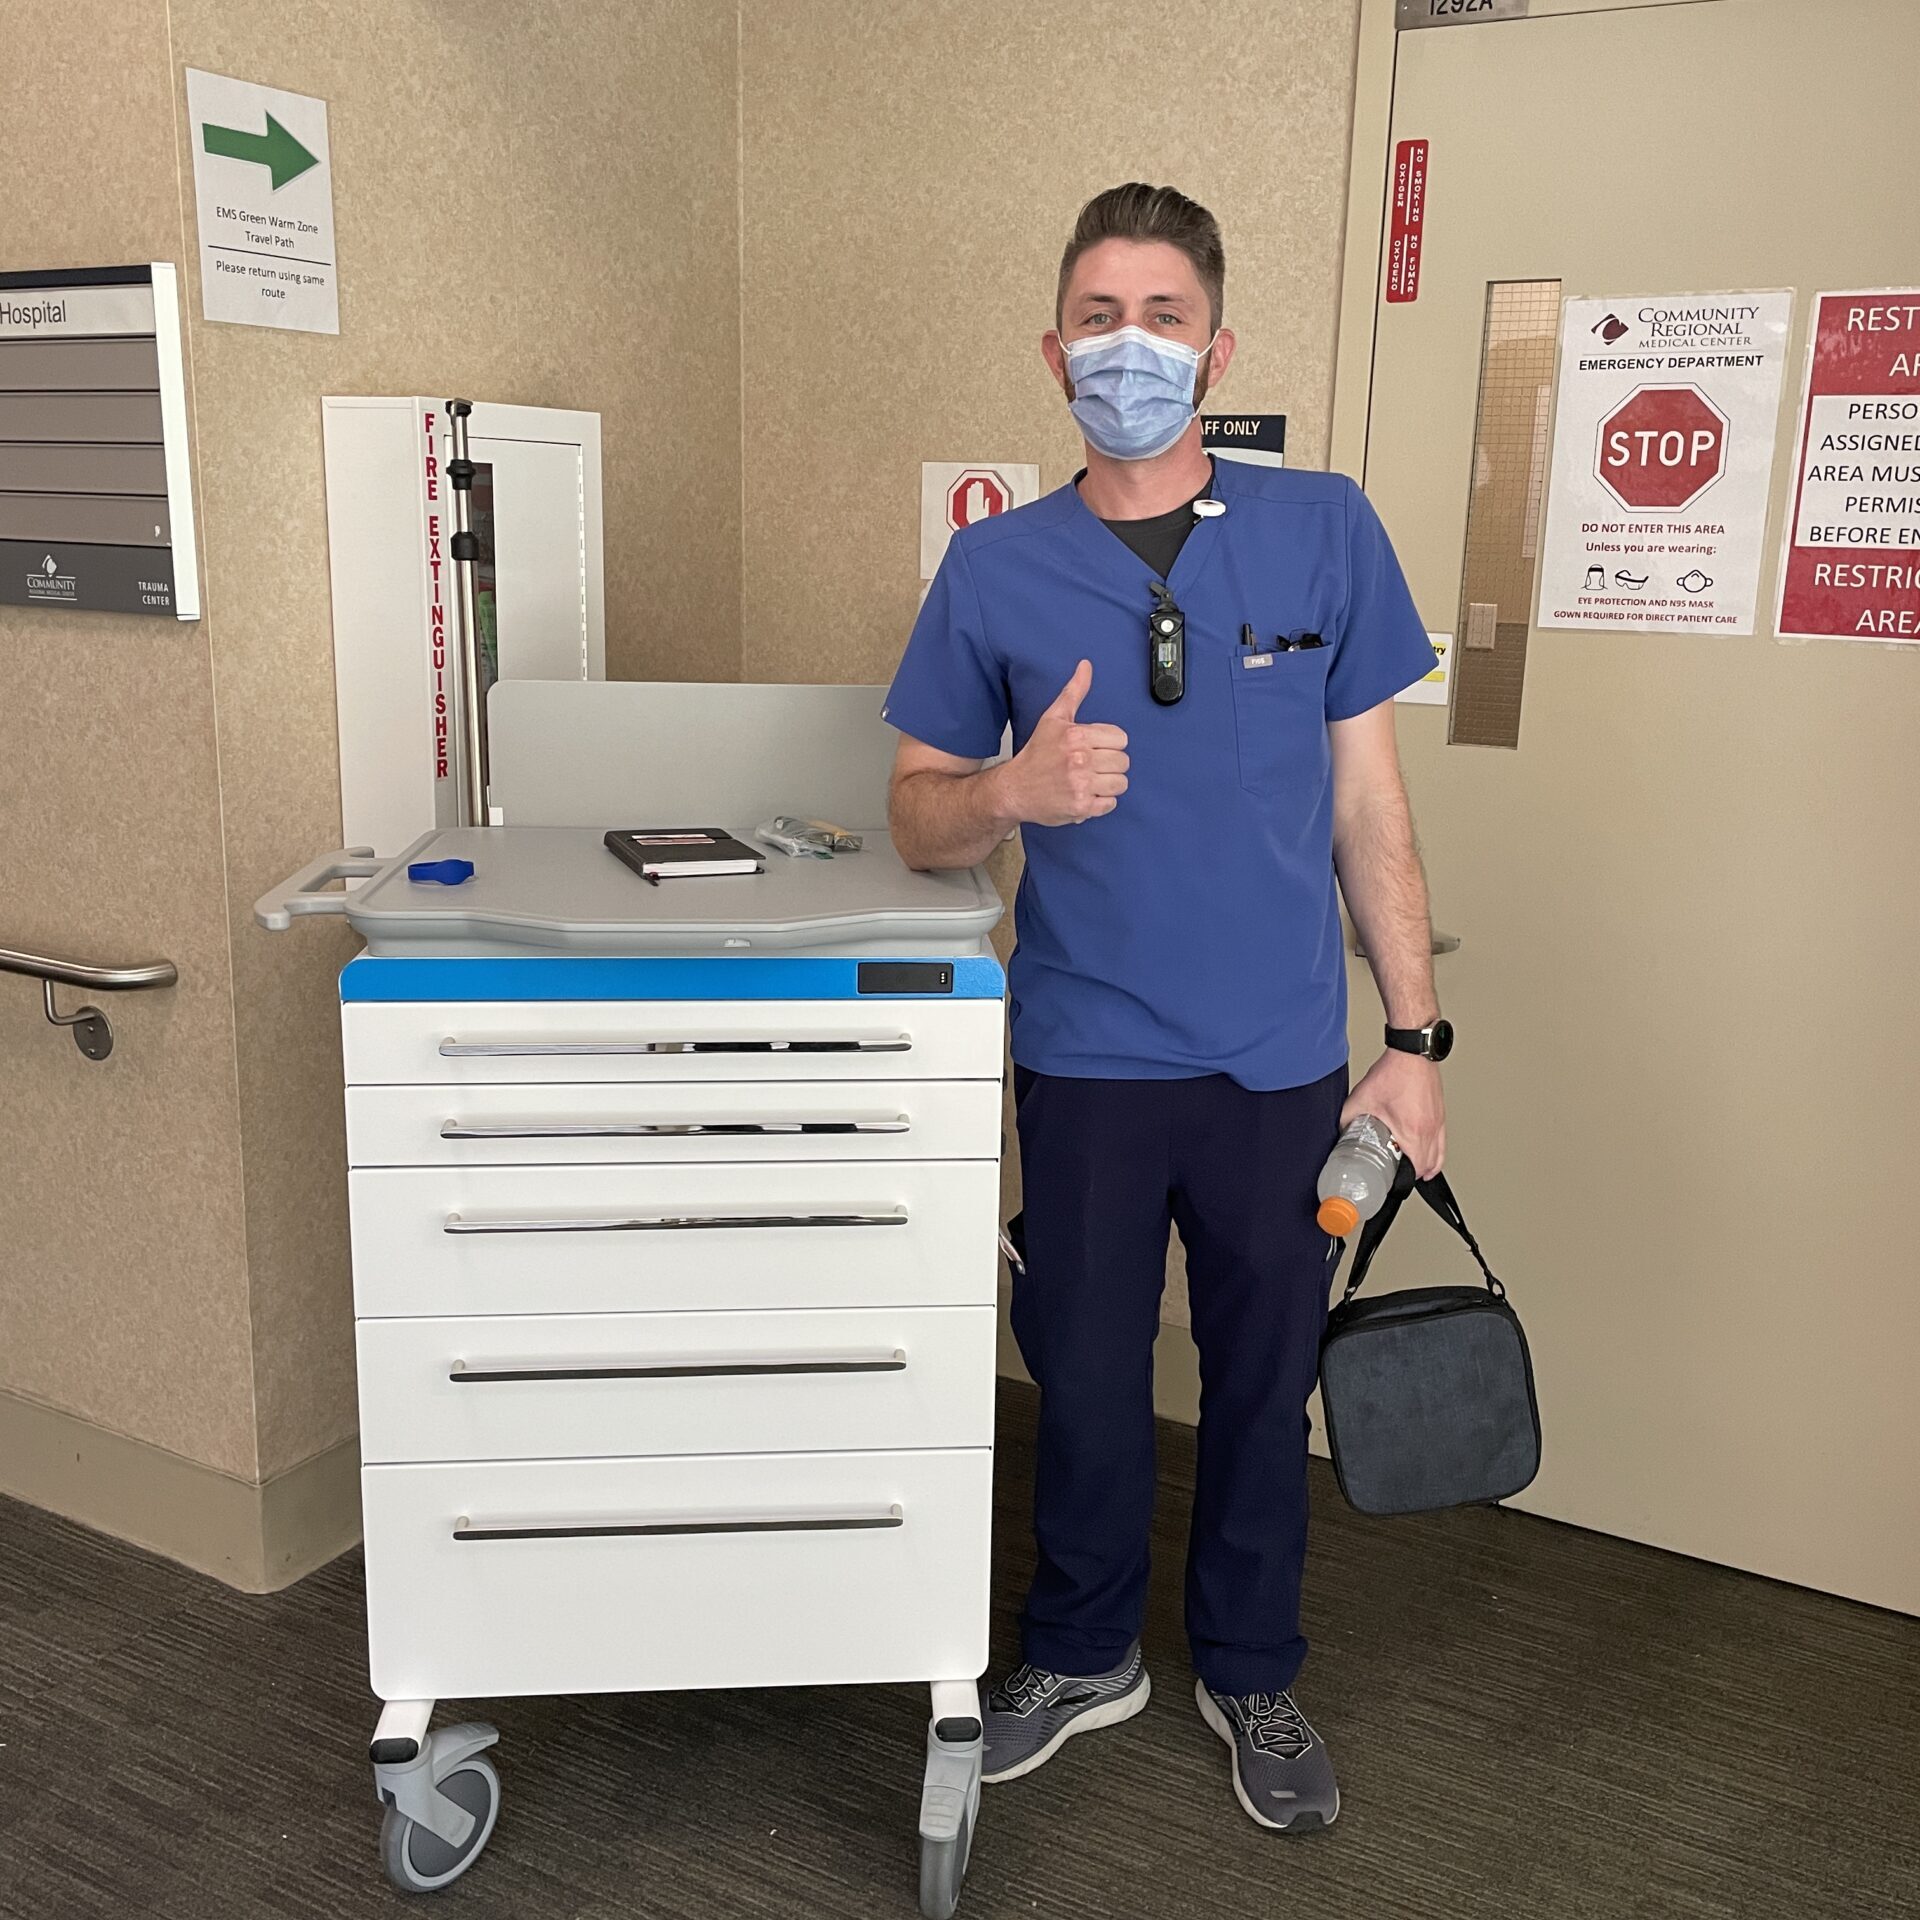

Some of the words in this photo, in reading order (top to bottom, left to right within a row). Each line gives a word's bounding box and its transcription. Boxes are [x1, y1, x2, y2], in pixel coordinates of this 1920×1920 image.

[1416, 148, 1424, 163] NO
[1397, 163, 1406, 207] OXYGEN
[1412, 170, 1422, 222] SMOKING
[216, 206, 236, 220] EMS
[239, 210, 266, 226] Green
[268, 215, 295, 230] Warm
[297, 220, 318, 234] Zone
[245, 230, 272, 245] Travel
[275, 235, 295, 248] Path
[1410, 235, 1417, 249] NO
[216, 260, 246, 275] Please
[248, 266, 276, 279] return
[278, 270, 301, 285] using
[302, 275, 325, 286] same
[1391, 240, 1401, 291] OXYGENO
[1407, 256, 1416, 293] FUMAR
[261, 287, 286, 299] route
[0, 300, 66, 329] Hospital
[1638, 306, 1760, 323] COMMUNITY
[1847, 306, 1920, 332] REST
[1650, 322, 1743, 338] REGIONAL
[1638, 337, 1696, 349] MEDICAL
[1700, 336, 1752, 347] CENTER
[1579, 357, 1665, 371] EMERGENCY
[1667, 355, 1765, 369] DEPARTMENT
[1849, 403, 1918, 420] PERSO
[1223, 421, 1260, 436] ONLY
[425, 413, 438, 501] FIRE
[1607, 430, 1715, 467] STOP
[1807, 465, 1864, 482] AREA
[1871, 466, 1920, 483] MUS
[1581, 523, 1598, 533] DO
[1601, 523, 1626, 533] NOT
[1628, 524, 1663, 534] ENTER
[1666, 524, 1692, 534] THIS
[1694, 524, 1725, 535] AREA
[1809, 526, 1891, 544] BEFORE
[1586, 542, 1621, 552] Unless
[1624, 544, 1646, 555] you
[1647, 544, 1665, 553] are
[1668, 543, 1717, 556] wearing:
[27, 576, 76, 591] COMMUNITY
[138, 581, 169, 593] TRAUMA
[142, 594, 170, 606] CENTER
[1578, 597, 1592, 605] EYE
[1594, 597, 1647, 607] PROTECTION
[1648, 598, 1668, 607] AND
[1669, 599, 1687, 608] N95
[1688, 600, 1714, 609] MASK
[1553, 610, 1581, 619] GOWN
[1583, 611, 1624, 622] REQUIRED
[1626, 612, 1644, 621] FOR
[1645, 613, 1675, 622] DIRECT
[1677, 614, 1713, 624] PATIENT
[1715, 615, 1737, 624] CARE
[429, 516, 448, 778] EXTINGUISHER
